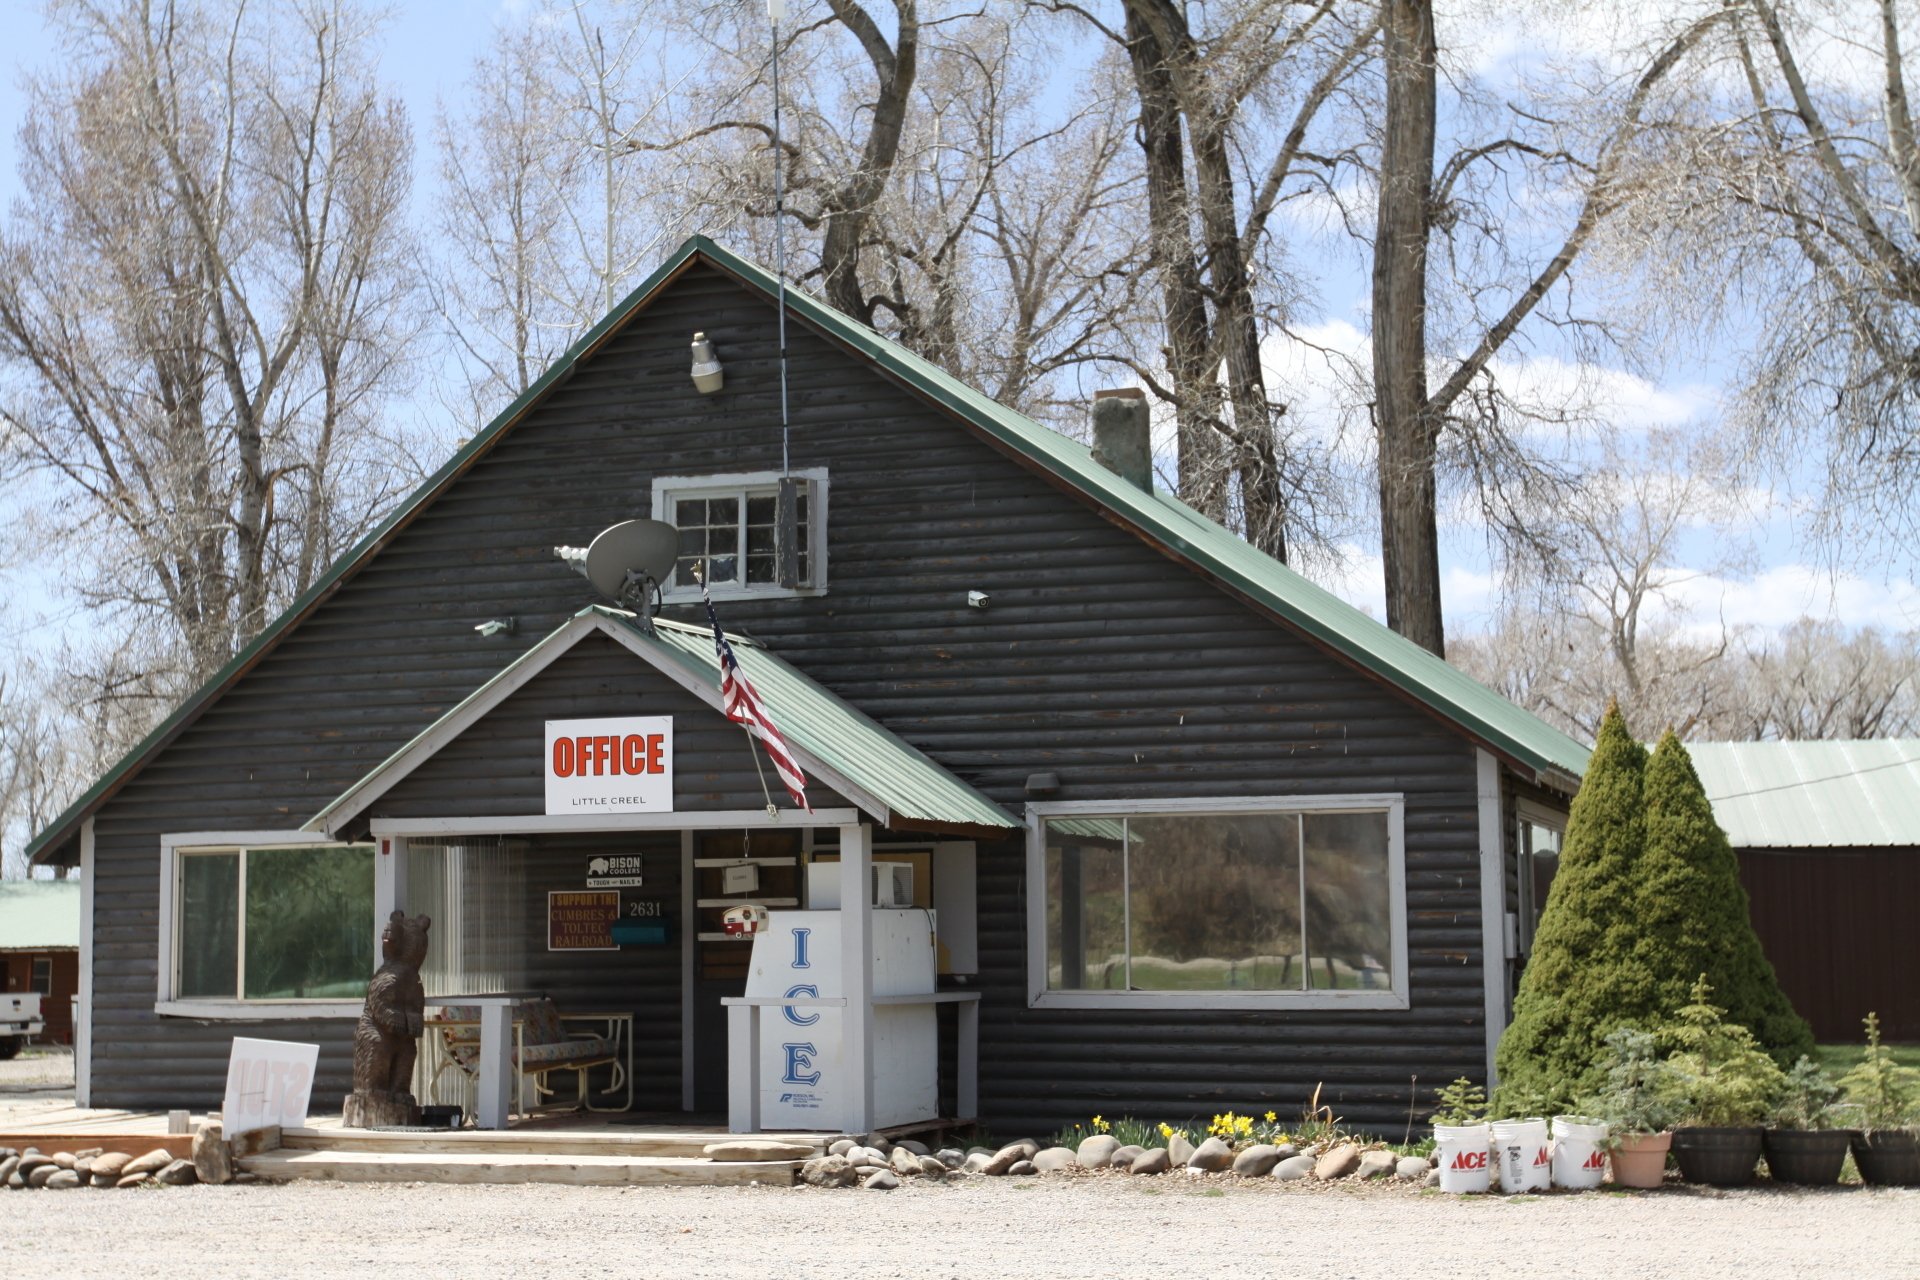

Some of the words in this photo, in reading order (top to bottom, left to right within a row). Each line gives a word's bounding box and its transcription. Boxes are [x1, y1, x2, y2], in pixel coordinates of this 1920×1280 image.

[553, 734, 664, 778] OFFICE
[572, 797, 607, 806] LITTLE
[611, 796, 646, 805] CREEL
[609, 857, 640, 869] BISON
[551, 895, 555, 906] I
[557, 894, 598, 906] SUPPORT
[600, 894, 617, 905] THE
[551, 909, 606, 921] CUMBRES
[608, 910, 617, 920] &
[630, 902, 661, 917] 2631
[562, 921, 606, 934] TOLTEC
[555, 935, 612, 948] RAILROAD
[781, 928, 821, 1086] ICE
[1451, 1150, 1487, 1170] ACE
